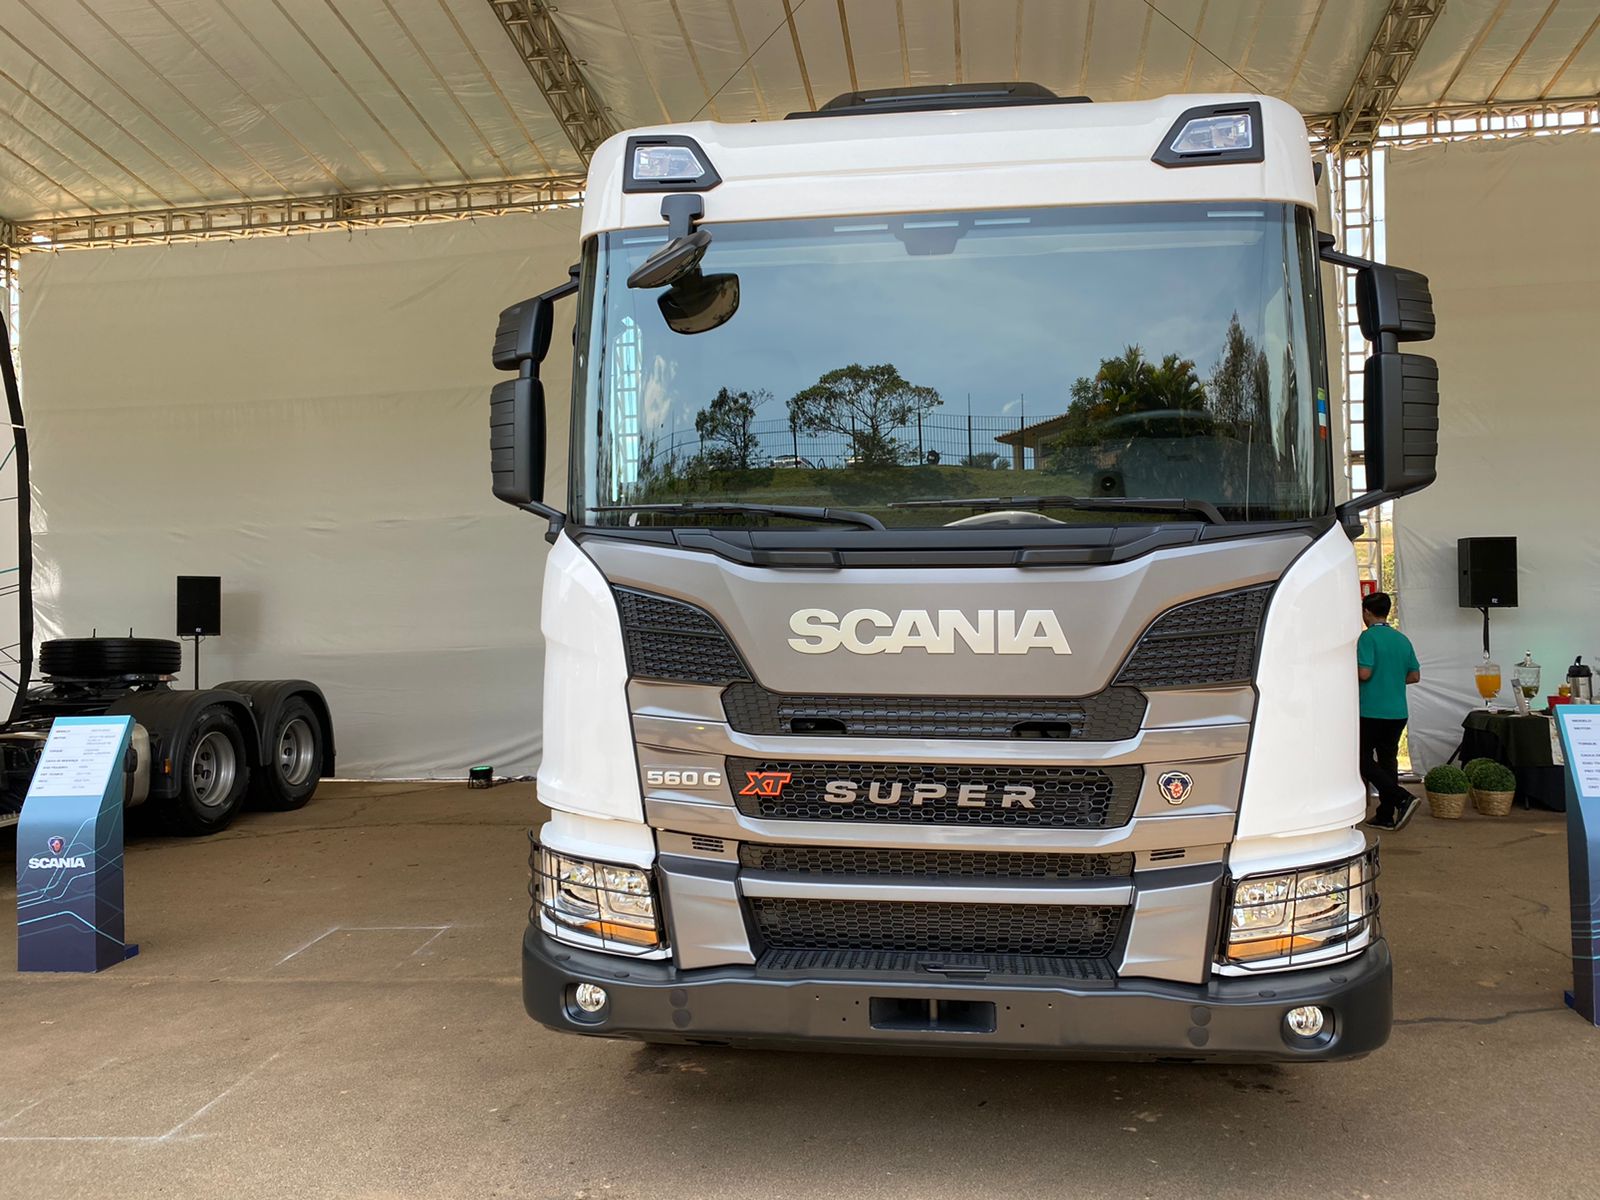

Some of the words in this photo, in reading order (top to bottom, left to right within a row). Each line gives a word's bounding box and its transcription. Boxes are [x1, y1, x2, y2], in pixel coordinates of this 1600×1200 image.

[787, 608, 1073, 655] SCANIA
[647, 770, 698, 785] 560
[703, 771, 721, 786] G
[739, 772, 791, 796] XT
[823, 780, 1036, 808] SUPER
[28, 857, 86, 869] SCANIA
